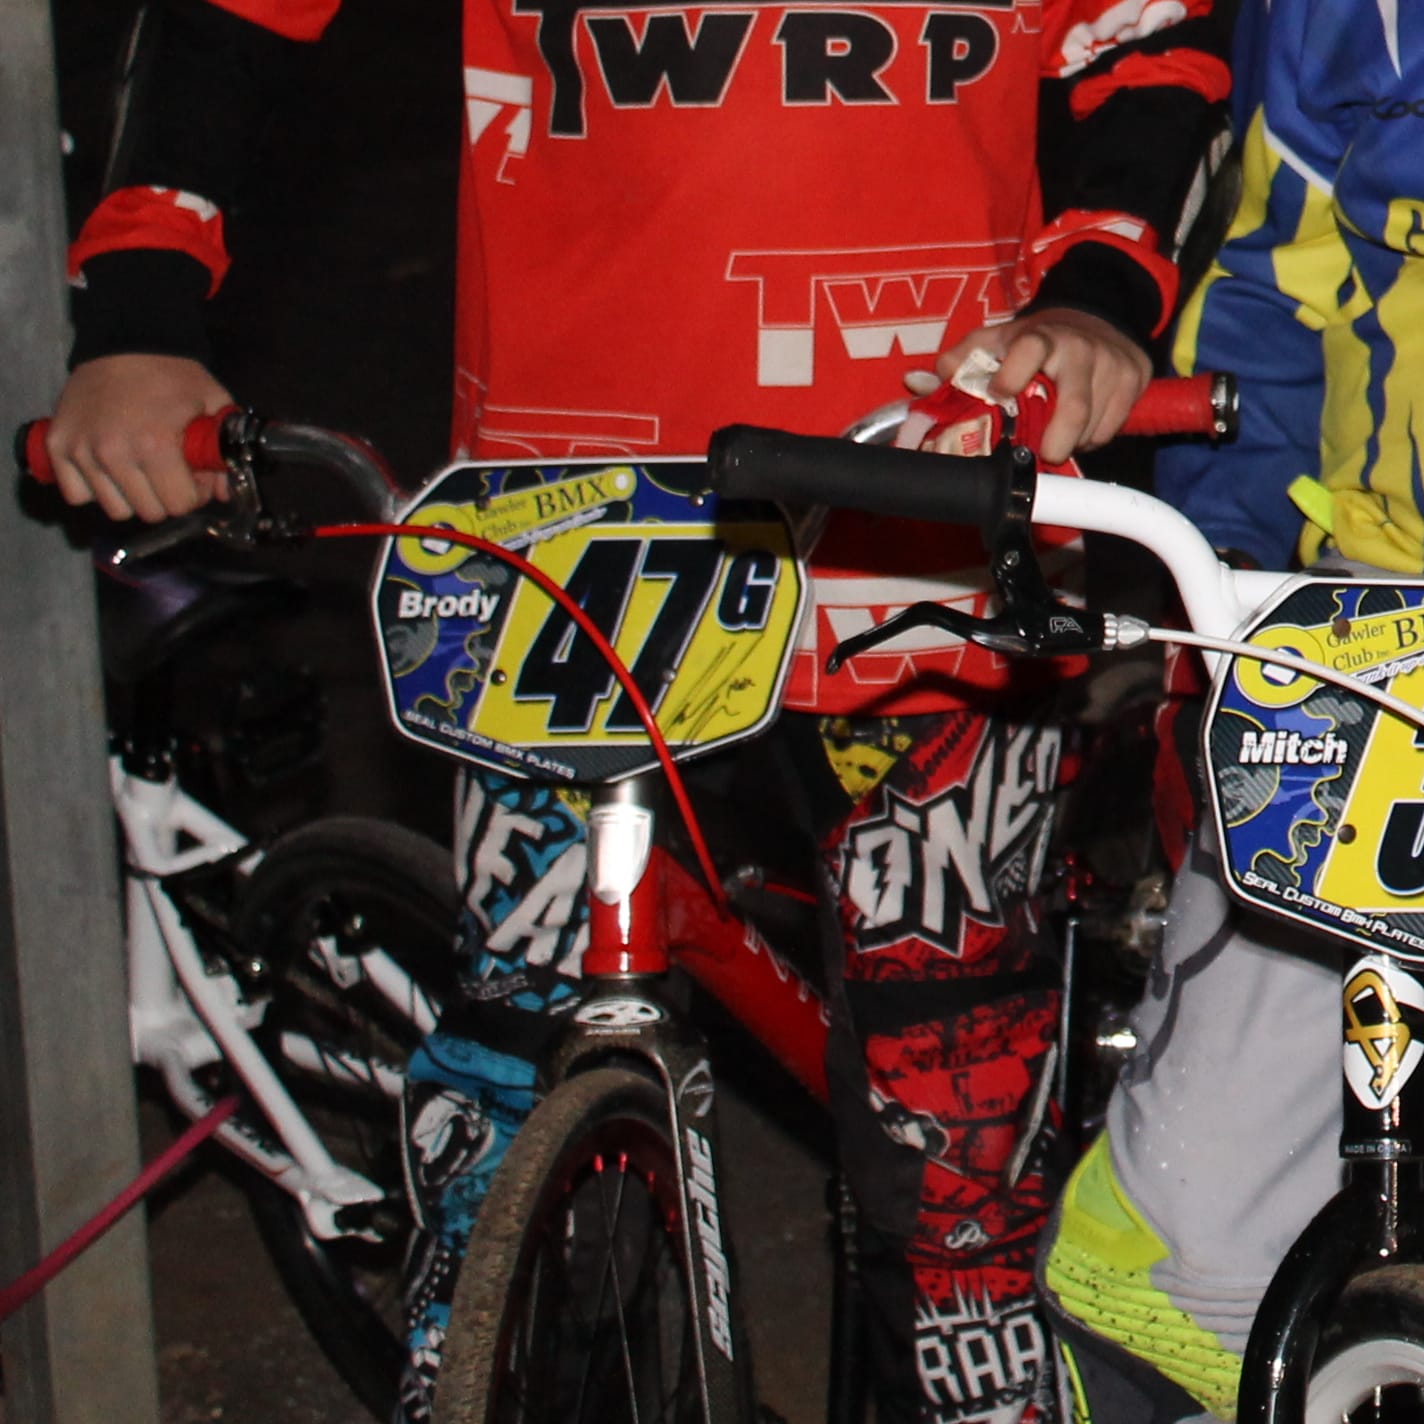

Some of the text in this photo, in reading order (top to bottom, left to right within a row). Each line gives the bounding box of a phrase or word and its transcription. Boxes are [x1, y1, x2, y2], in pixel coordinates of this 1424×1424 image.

[534, 475, 610, 520] BMX
[399, 588, 500, 622] Brody
[513, 538, 722, 734] 47
[717, 550, 778, 632] G
[1332, 649, 1374, 672] Club
[1238, 730, 1349, 766] Mitch
